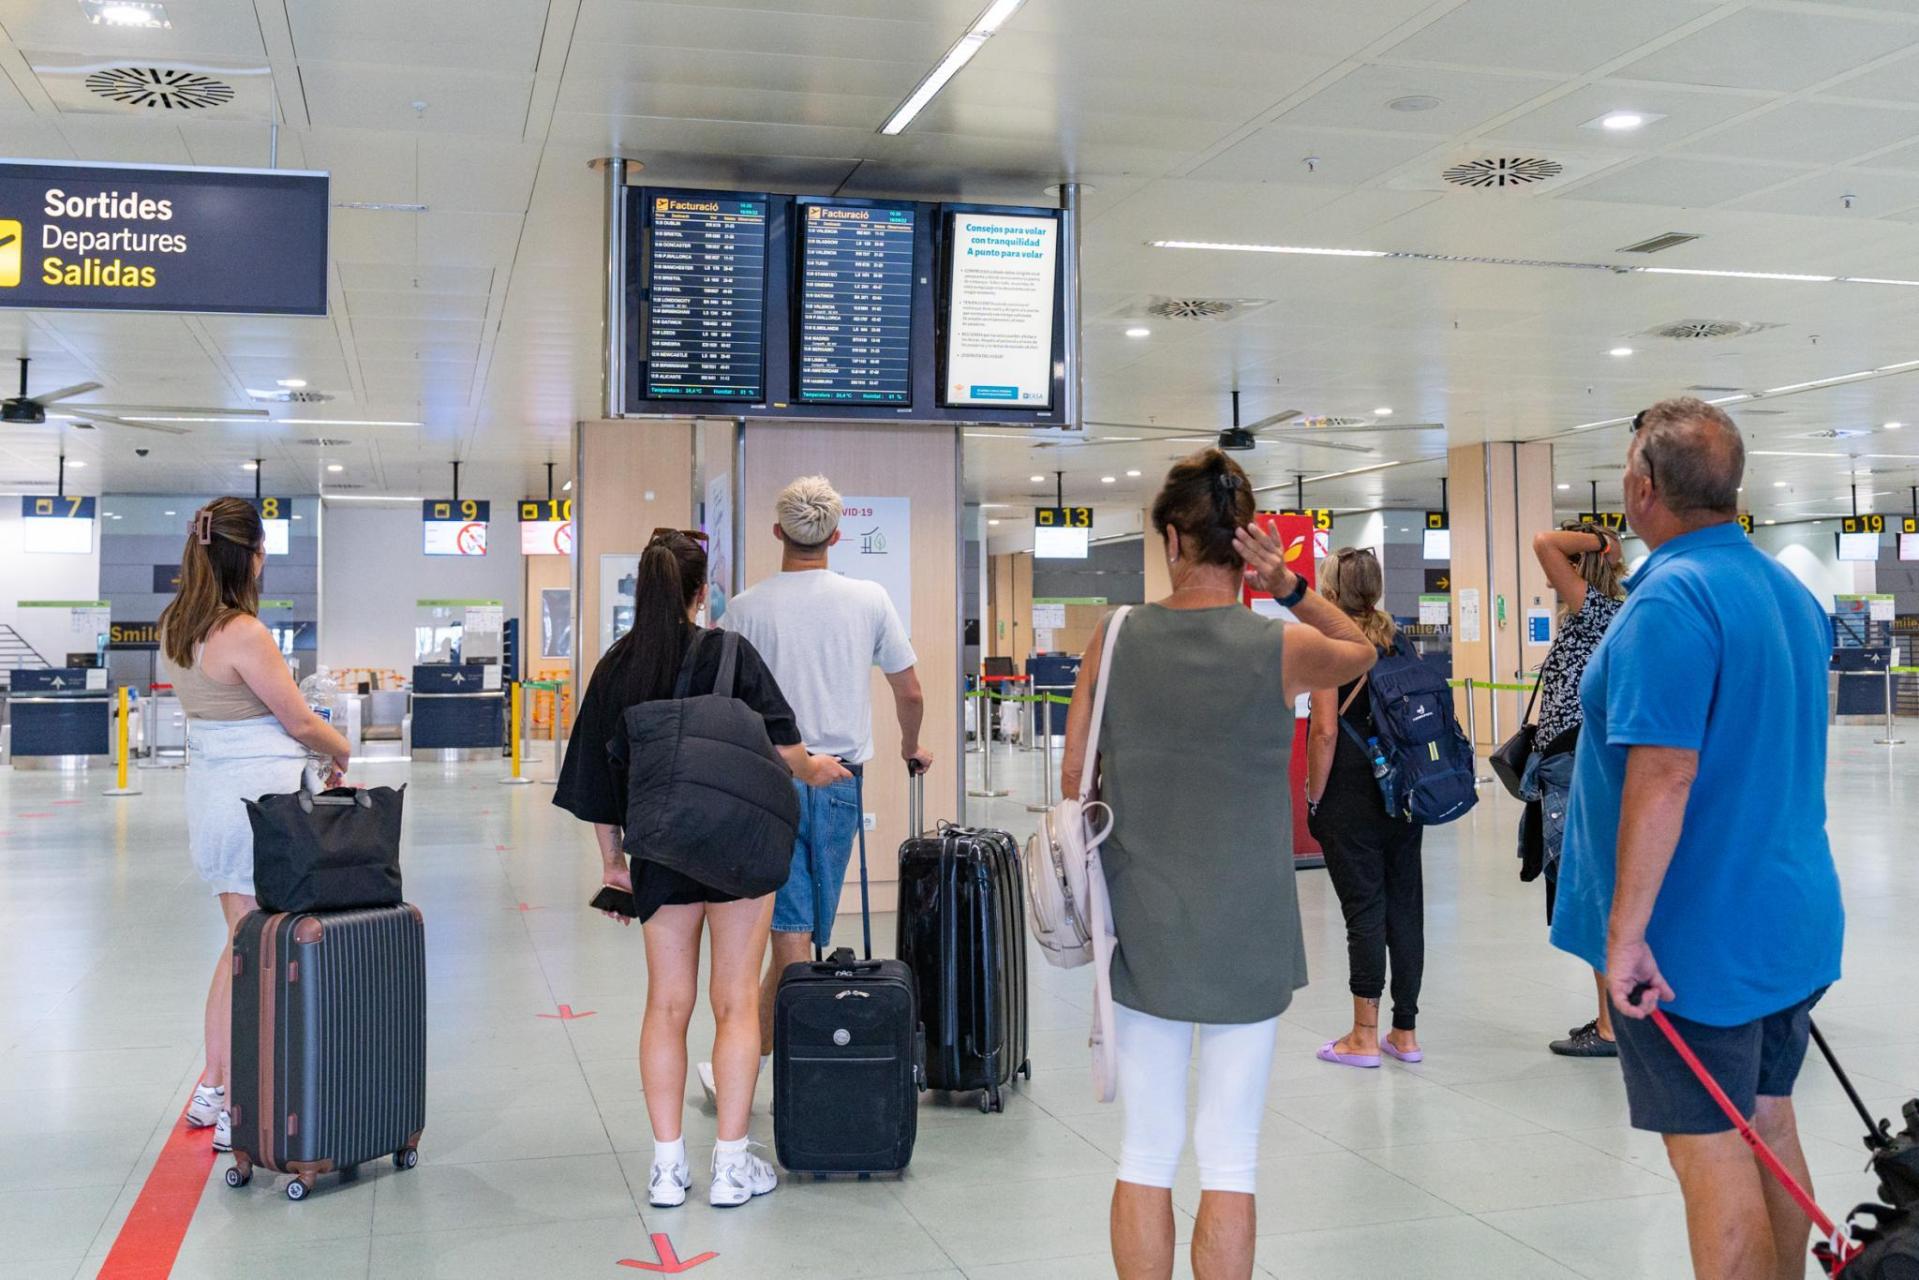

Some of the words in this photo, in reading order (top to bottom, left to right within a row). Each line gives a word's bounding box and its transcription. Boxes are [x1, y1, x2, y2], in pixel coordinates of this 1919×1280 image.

[44, 188, 173, 221] Sortides
[670, 201, 719, 211] Facturació
[822, 209, 869, 219] Facturació
[42, 223, 187, 255] Departures
[966, 224, 1003, 234] Consejos
[1004, 226, 1023, 235] para
[988, 238, 1040, 247] tranquilidad
[975, 249, 1000, 257] punto
[42, 256, 157, 288] Salidas
[65, 496, 82, 517] 7
[262, 497, 279, 519] 8
[461, 500, 477, 521] 9
[842, 508, 873, 517] VID-19
[1062, 507, 1089, 528] 13
[1600, 512, 1623, 530] 17
[1861, 514, 1882, 533] 19
